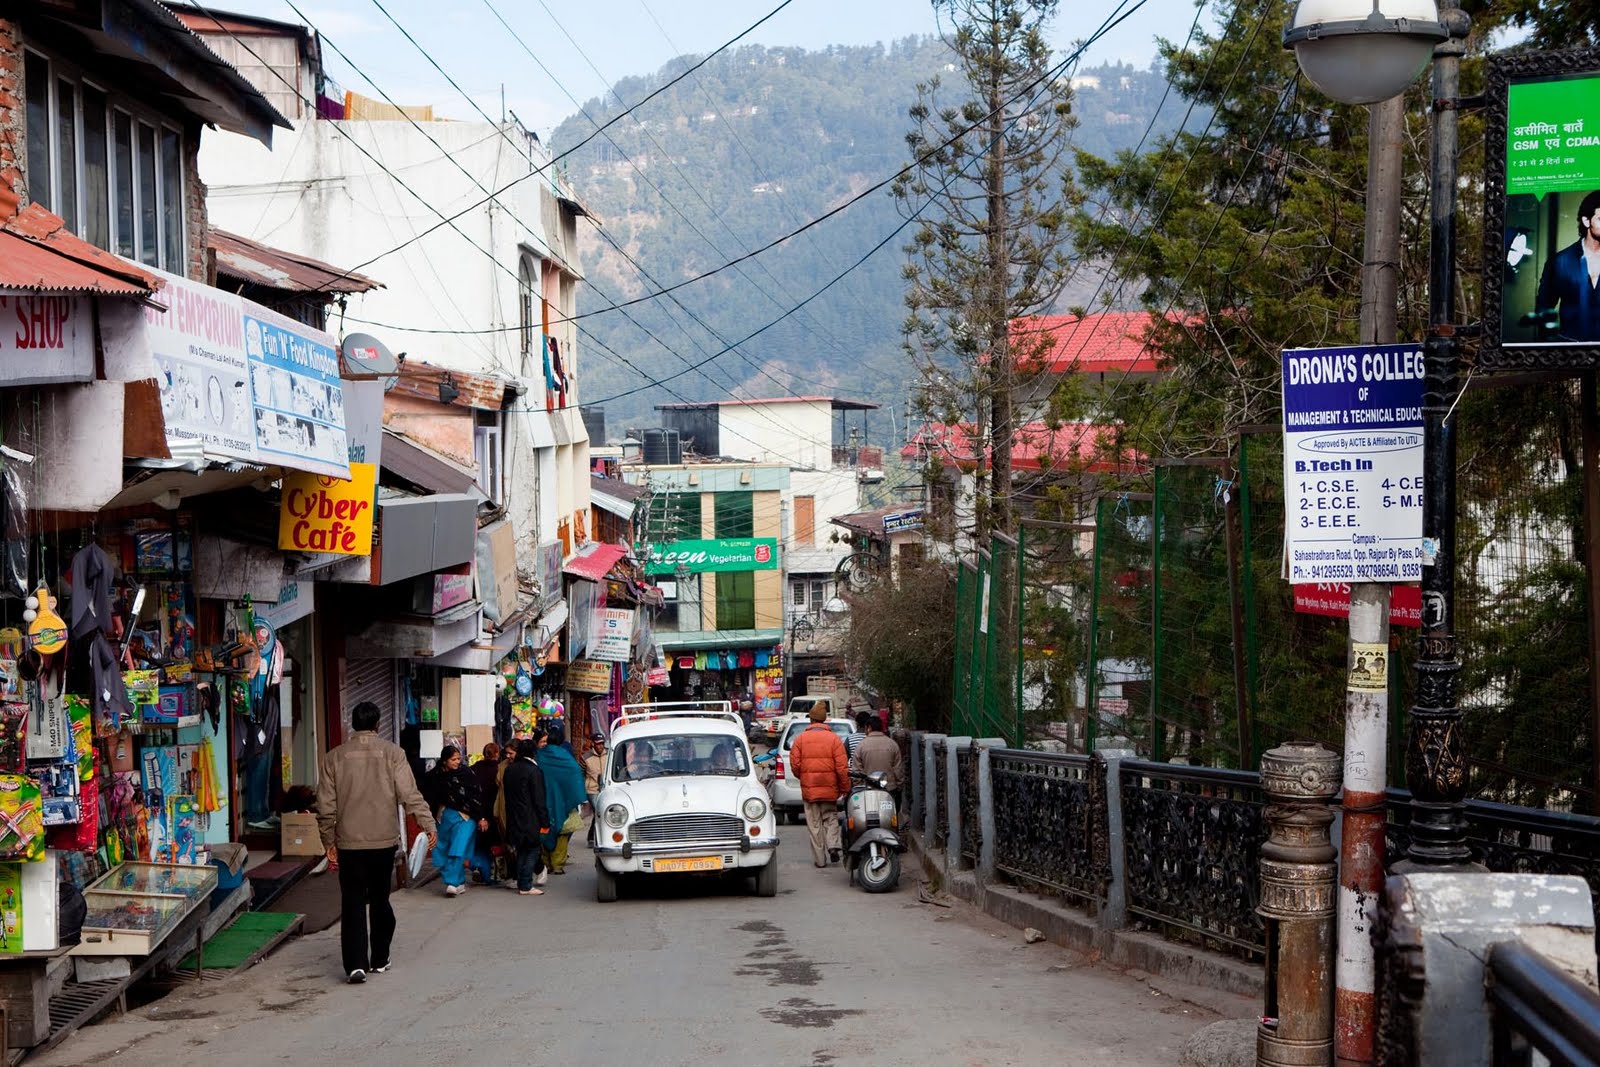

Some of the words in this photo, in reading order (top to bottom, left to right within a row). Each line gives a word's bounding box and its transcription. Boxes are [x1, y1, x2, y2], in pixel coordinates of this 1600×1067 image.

[1513, 140, 1538, 150] GSM
[1566, 136, 1600, 147] CDMA
[16, 296, 70, 350] SHOP
[176, 286, 242, 351] EMPORIUM
[262, 326, 278, 358] Fun
[290, 336, 308, 367] Food
[309, 344, 340, 380] Kingdom
[1289, 354, 1357, 385] DRONA'S
[1362, 350, 1426, 382] COLLEG
[1358, 387, 1369, 401] OF
[1288, 410, 1341, 426] MANAGEMENT
[1343, 410, 1349, 423] &
[1350, 408, 1394, 423] TECHNICAL
[1396, 406, 1424, 420] EDUCA
[1314, 439, 1339, 450] Approved
[1340, 438, 1348, 449] By
[1349, 438, 1366, 447] AICTE
[1367, 437, 1372, 446] &
[1372, 436, 1396, 446] Affiliated
[1398, 436, 1405, 445] To
[1405, 436, 1418, 445] UTU
[1295, 459, 1352, 472] B.Tech
[1355, 458, 1373, 470] In
[1300, 482, 1312, 493] 1-
[1316, 480, 1359, 493] C.S.E.
[1381, 478, 1396, 490] 4-
[287, 488, 368, 520] Cyber
[1300, 498, 1313, 510] 2-
[1317, 496, 1360, 510] E.C.E.
[1383, 496, 1396, 508] 5-
[1301, 516, 1314, 528] 3-
[1318, 514, 1360, 528] E.E.E.
[292, 520, 356, 552] Café
[1352, 533, 1376, 546] Campus
[1294, 550, 1335, 560] Sahastradhara
[1354, 548, 1367, 562] Opp.
[1369, 548, 1388, 562] Rajpur
[1389, 548, 1397, 562] By
[1398, 548, 1414, 560] Pass,
[48, 698, 56, 728] SNIPER
